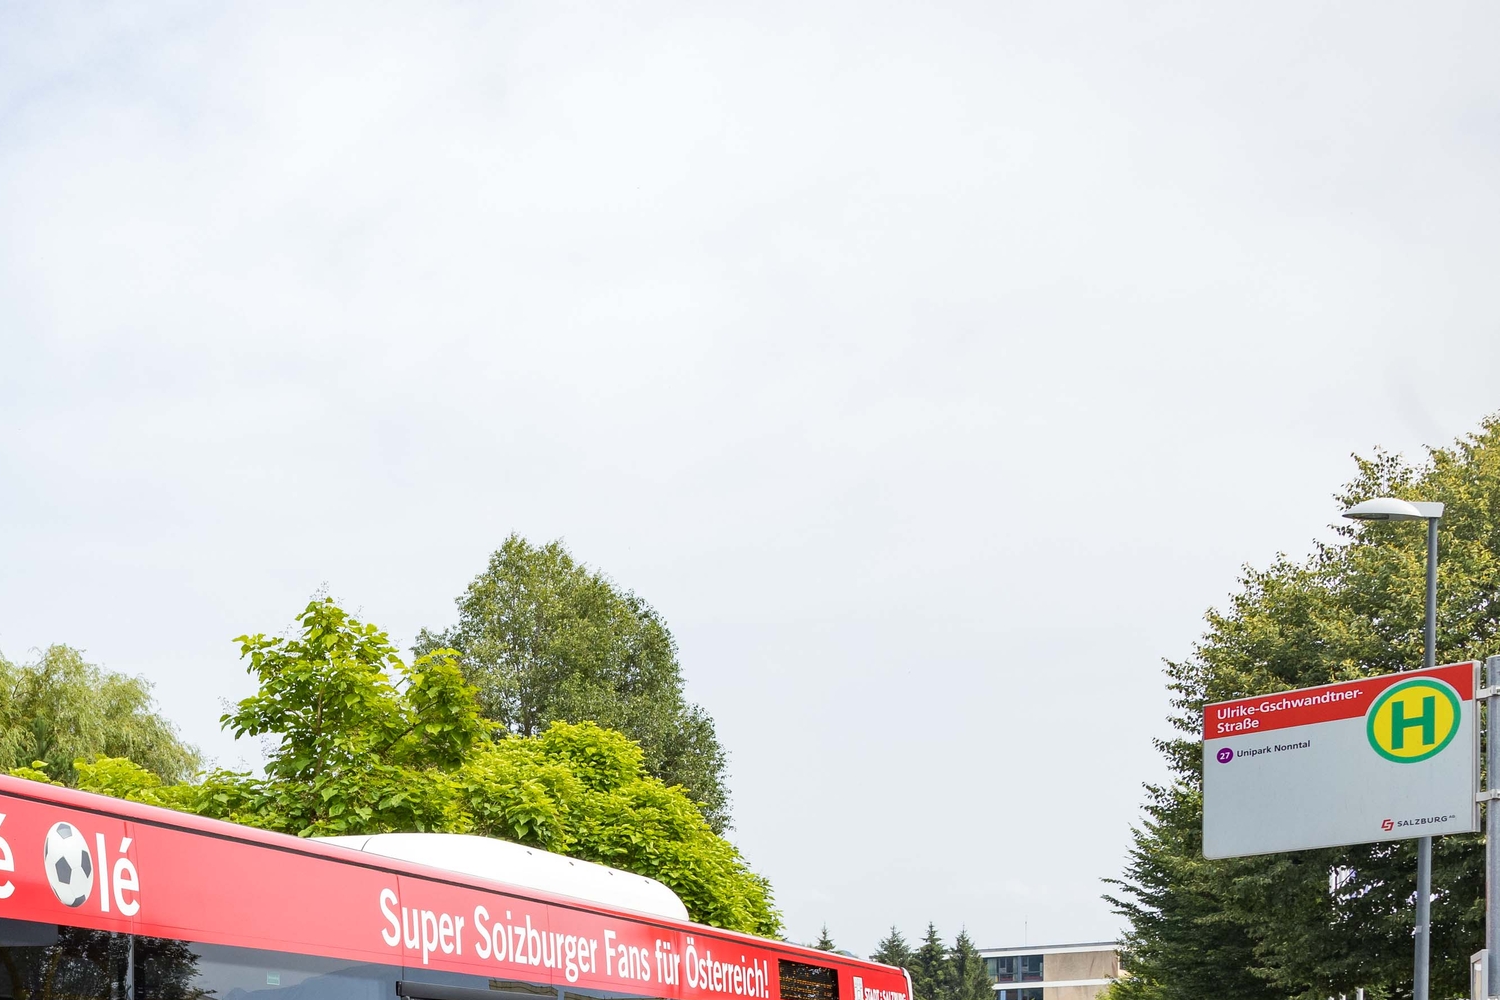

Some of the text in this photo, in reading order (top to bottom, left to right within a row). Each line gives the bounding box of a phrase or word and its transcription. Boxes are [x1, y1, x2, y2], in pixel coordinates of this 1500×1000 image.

[1216, 688, 1364, 720] Ulrike-Gschwandtner-
[1216, 718, 1260, 734] Straße
[1391, 695, 1436, 750] H
[1220, 751, 1231, 761] 27
[1236, 740, 1311, 758] Unipark Nonntal
[1397, 815, 1448, 828] SALZBURG
[379, 886, 465, 965] Super
[474, 904, 599, 984] Soizburger
[603, 928, 651, 982] Fans
[654, 939, 680, 986] für
[685, 937, 770, 998] Österreich!
